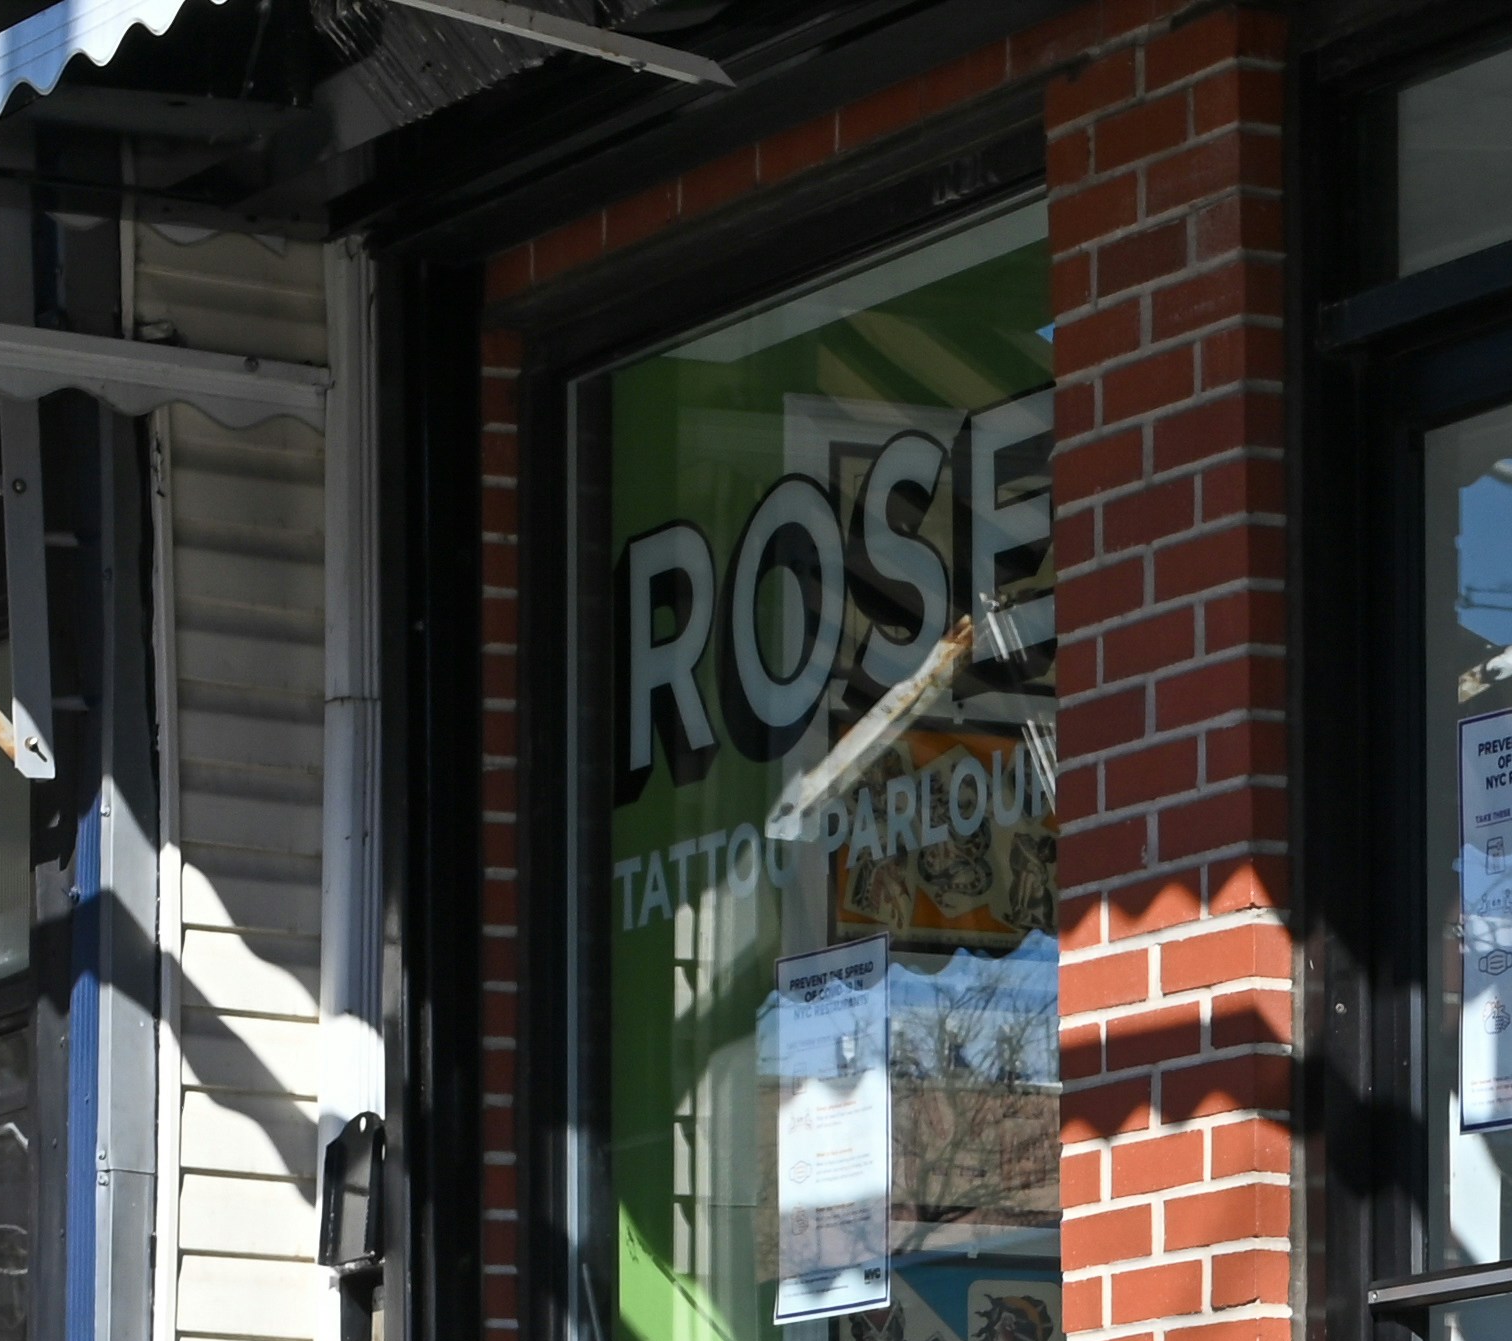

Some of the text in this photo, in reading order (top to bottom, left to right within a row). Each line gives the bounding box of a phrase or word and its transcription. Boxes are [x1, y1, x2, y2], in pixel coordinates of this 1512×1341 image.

[628, 394, 1056, 772] ROSE
[1497, 754, 1511, 769] OF
[1485, 773, 1506, 790] NYC
[614, 808, 800, 931] TATTOO
[790, 972, 827, 990] PREVENT
[845, 960, 874, 979] SPREAD
